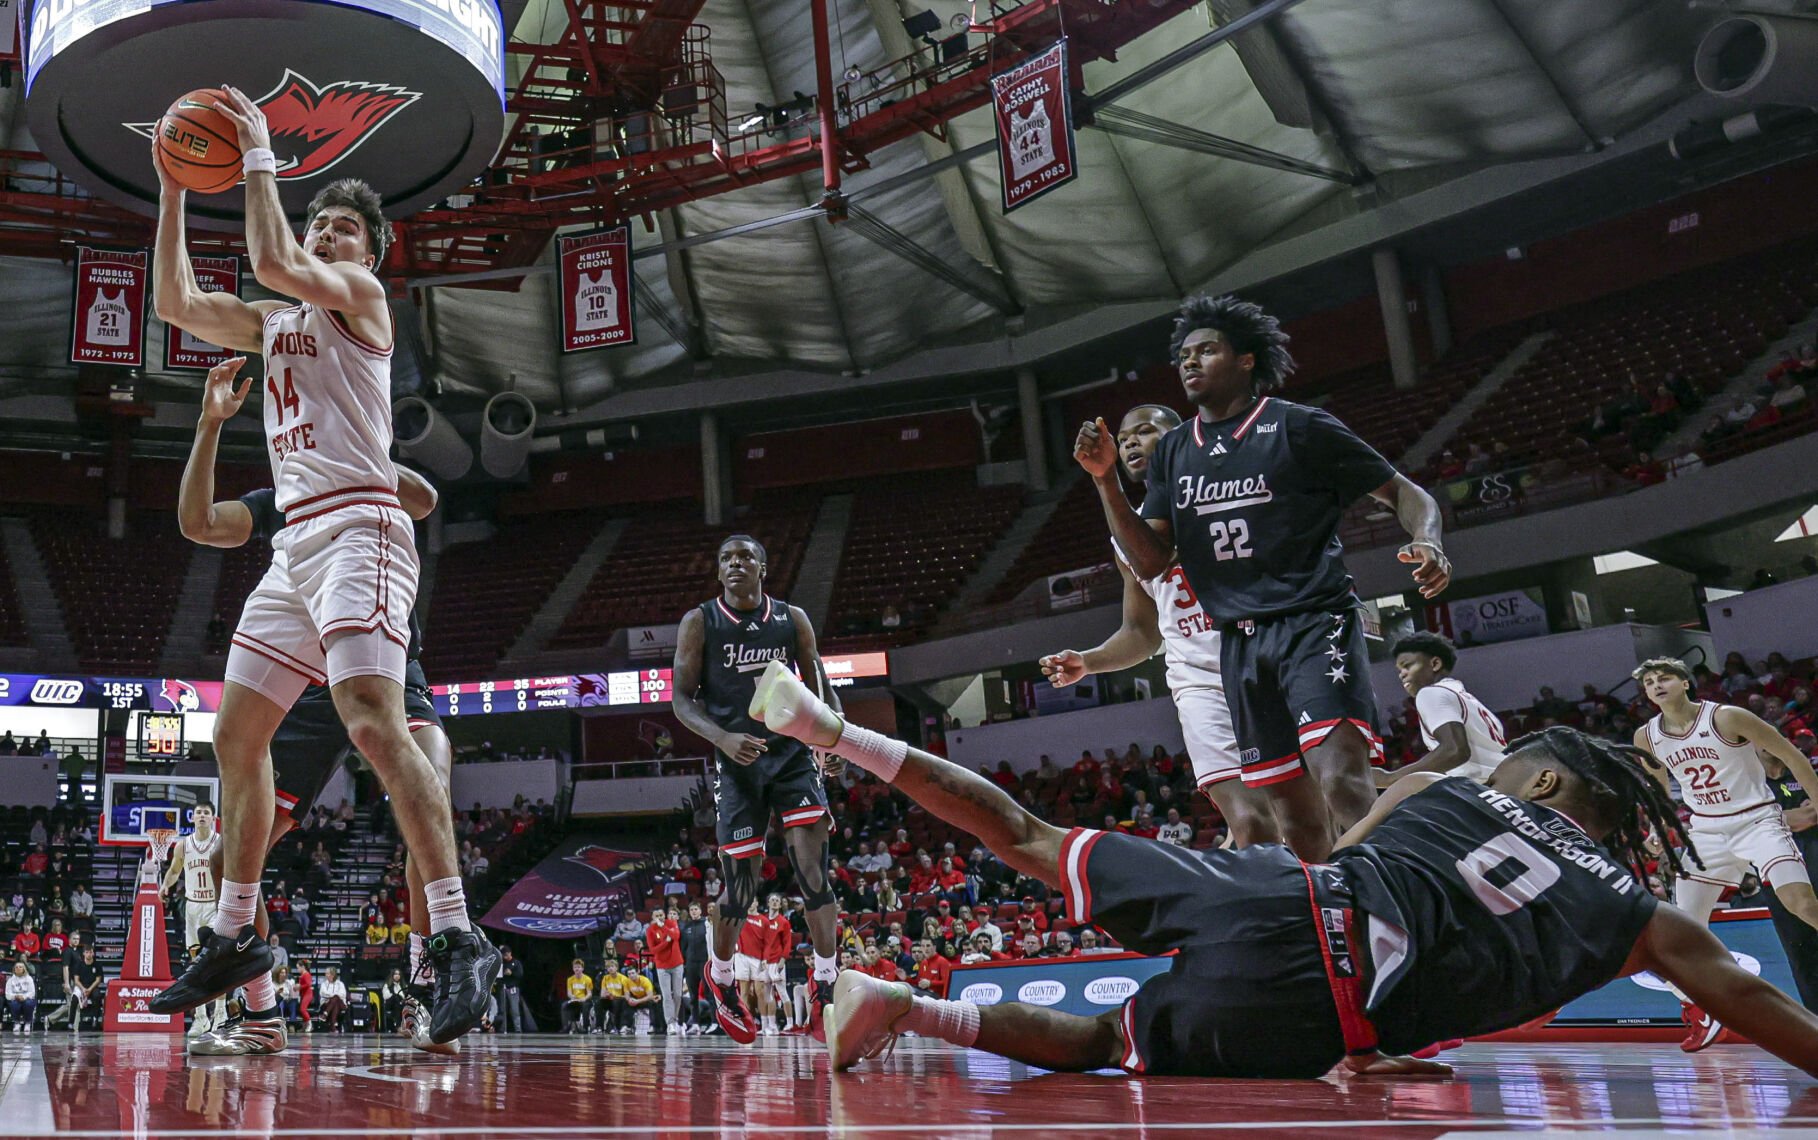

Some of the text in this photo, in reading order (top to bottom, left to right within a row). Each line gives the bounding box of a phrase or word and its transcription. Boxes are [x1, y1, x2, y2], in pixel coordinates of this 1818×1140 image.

[1009, 77, 1043, 99] CATHY
[1004, 84, 1050, 113] BOSWELL
[165, 121, 209, 154] ELITE
[1014, 119, 1045, 142] ILLINOIS
[1019, 131, 1041, 151] 44
[1020, 146, 1043, 166] STATE
[1010, 180, 1032, 198] 1979
[1040, 163, 1066, 182] 1983
[579, 250, 610, 261] KRISTI
[576, 258, 613, 270] CIRONE
[89, 276, 136, 286] HAWKINS
[91, 268, 134, 278] BUBBLES
[201, 284, 225, 292] KINS
[581, 286, 612, 299] ILLINOIS
[94, 304, 125, 315] ILLINOIS
[588, 296, 605, 310] 10
[100, 313, 117, 327] 21
[586, 310, 609, 321] STATE
[97, 327, 120, 337] STATE
[270, 331, 318, 358] NOIS
[80, 349, 103, 358] 1972
[112, 351, 135, 360] 1975
[176, 354, 198, 362] 1974
[267, 366, 300, 427] 14
[1177, 473, 1272, 509] Flames
[1209, 518, 1253, 561] 22
[1480, 597, 1519, 619] OSF
[1177, 611, 1214, 638] STA
[723, 643, 788, 668] Flames
[648, 669, 658, 680] 0
[34, 681, 80, 701] UIC
[103, 683, 143, 697] 18:55
[447, 677, 568, 695] 14 22 35 PLAYER
[642, 680, 665, 691] 100
[112, 698, 134, 708] 1ST
[449, 688, 569, 705] 0 2 0 POINTS
[649, 692, 659, 702] 0
[449, 699, 566, 715] 0 0 0 FOULS
[1666, 747, 1720, 768] ILLINOIS
[1684, 764, 1720, 790] 22
[1694, 789, 1731, 806] STATE
[187, 859, 210, 870] ILLINO
[197, 872, 207, 889] 11
[1455, 831, 1562, 916] 0
[193, 889, 214, 899] STATE
[141, 905, 152, 977] HELLER
[965, 988, 998, 999] COUNTRY
[1024, 985, 1060, 997] COUNTRY
[1090, 982, 1133, 995] COUNTRY
